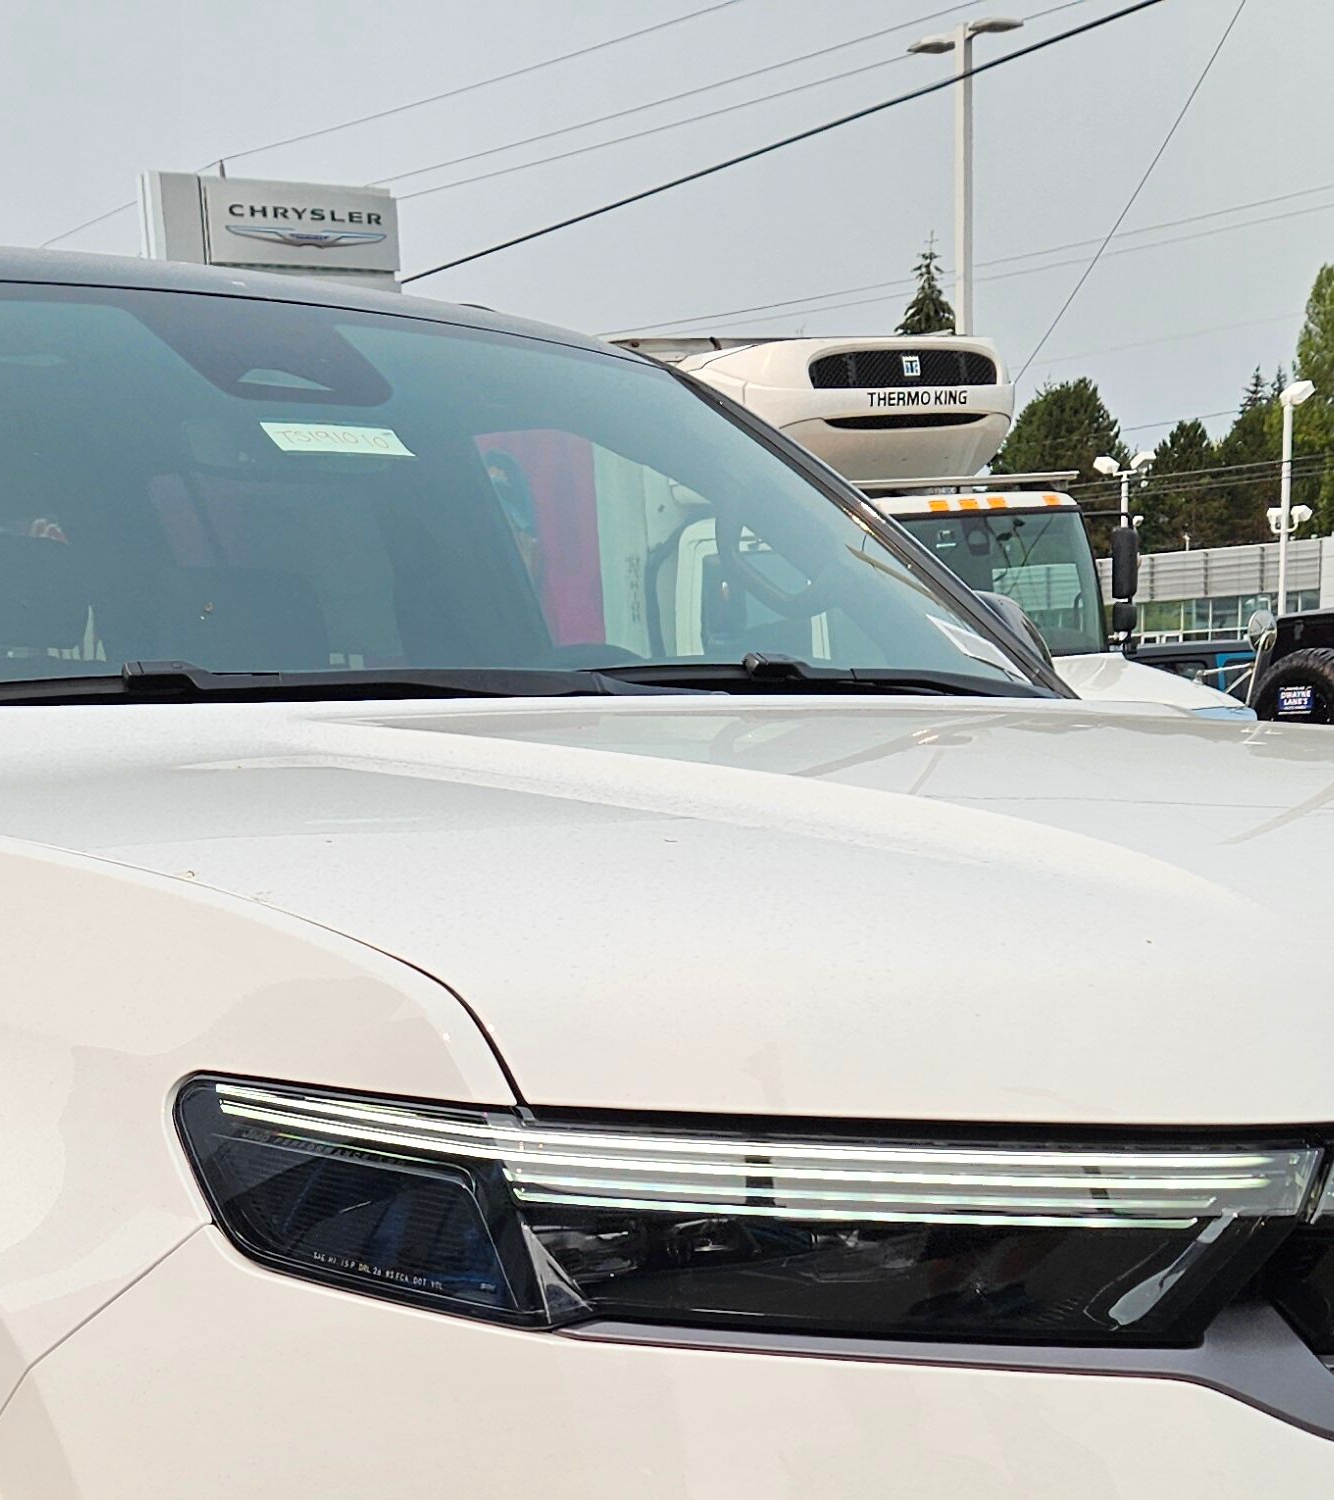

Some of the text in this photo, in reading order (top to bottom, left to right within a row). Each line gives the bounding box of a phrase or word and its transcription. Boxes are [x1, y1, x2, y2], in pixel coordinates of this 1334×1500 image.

[228, 203, 383, 226] CHRYSLER
[867, 389, 968, 408] THERMO KING
